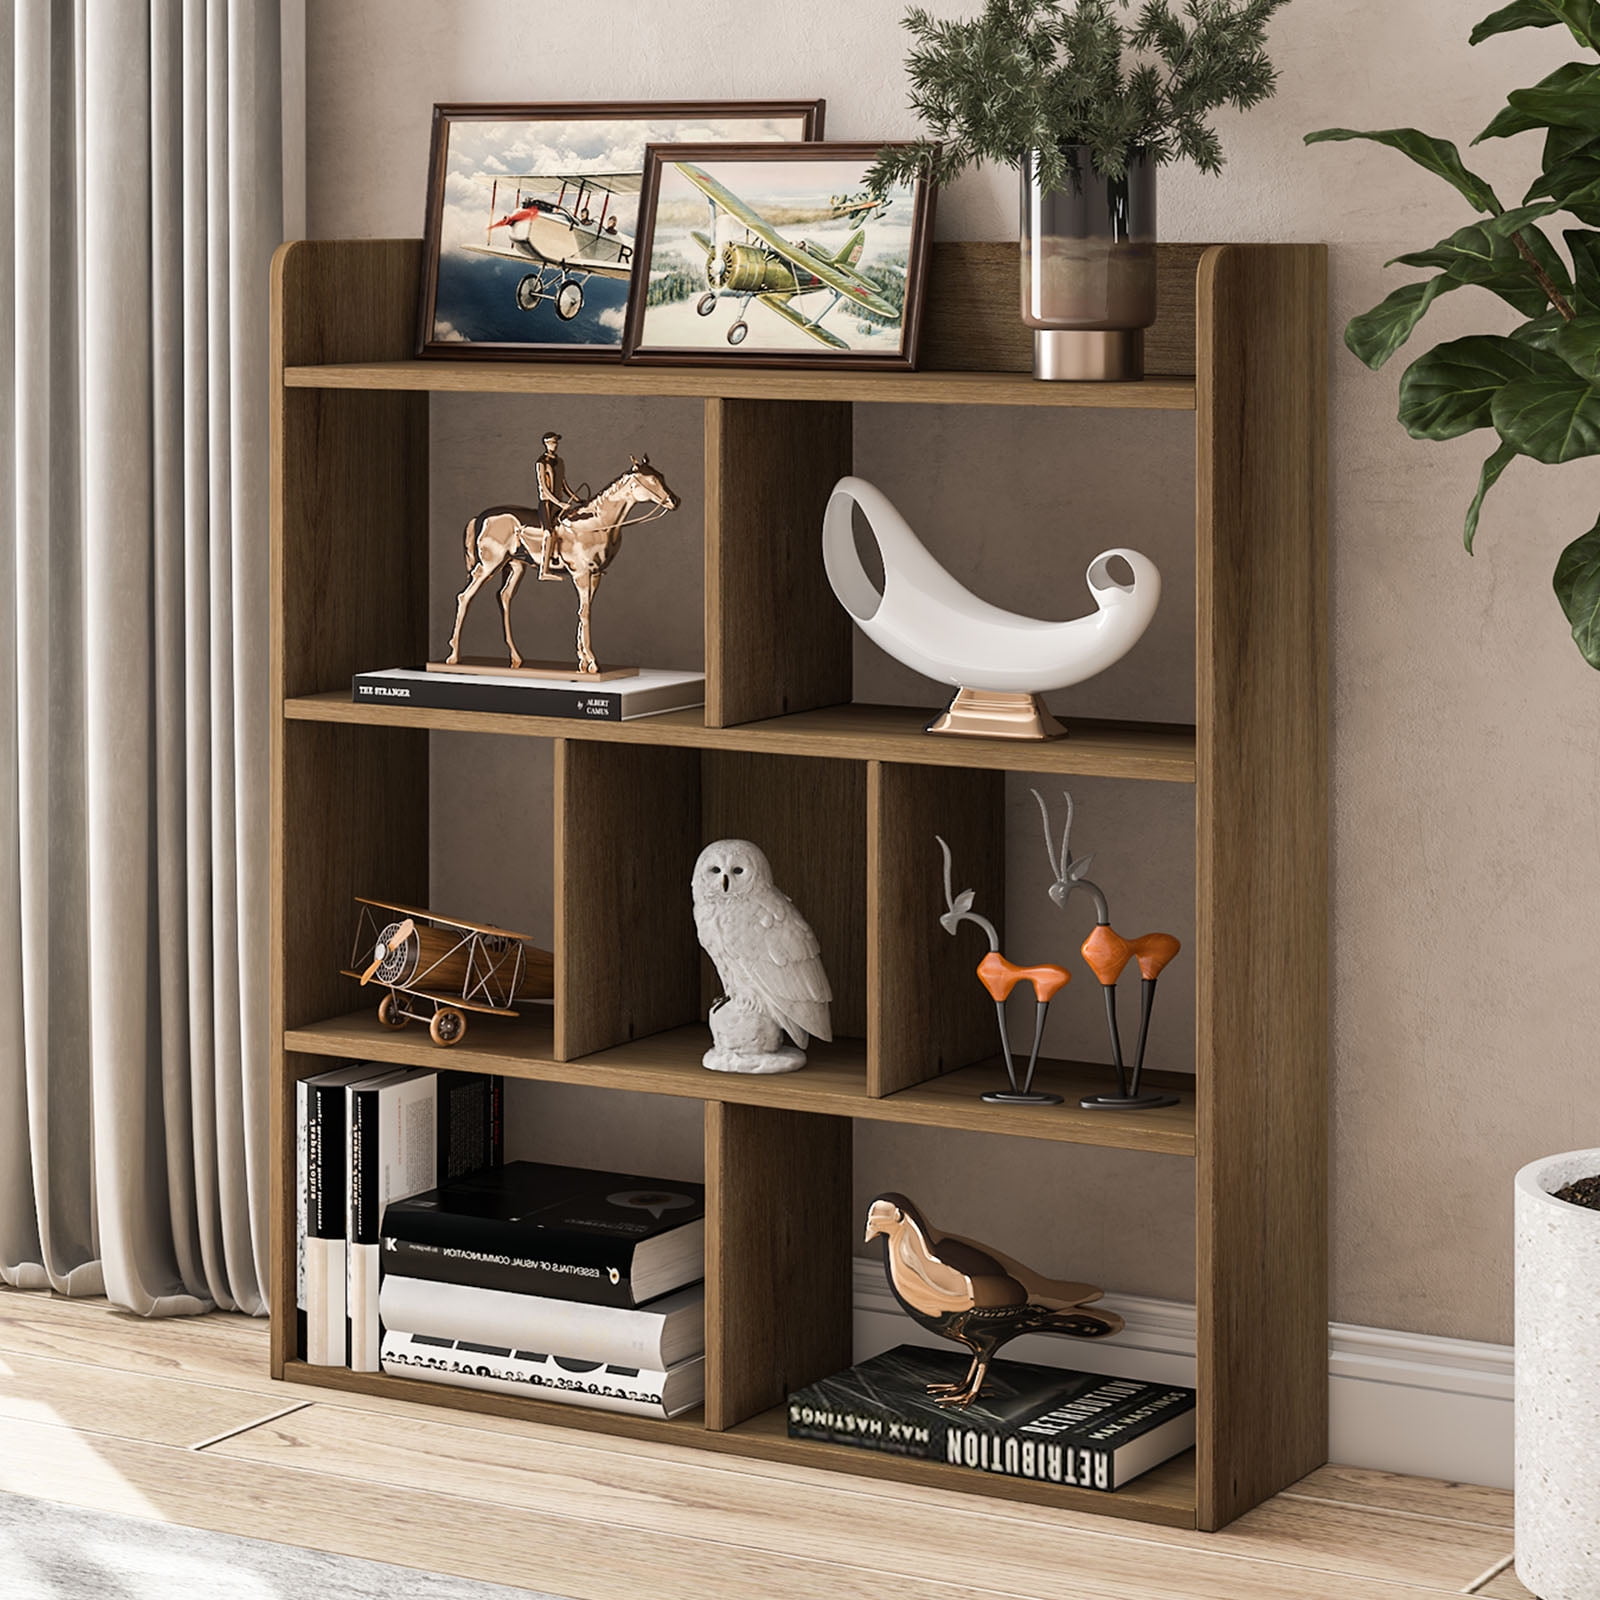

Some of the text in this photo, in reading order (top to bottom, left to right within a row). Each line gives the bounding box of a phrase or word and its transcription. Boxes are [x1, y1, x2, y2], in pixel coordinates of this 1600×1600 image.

[617, 245, 633, 264] R
[359, 686, 410, 698] THE STRANGER
[577, 701, 583, 710] by
[587, 699, 609, 708] ALBERT
[587, 707, 609, 716] CAMUS
[1018, 1380, 1149, 1436] RETRIBUTION
[1088, 1422, 1127, 1441] MAX
[1118, 1391, 1188, 1425] HASTINGS
[789, 1405, 883, 1435] HASTINGS
[889, 1422, 930, 1443] MAX
[946, 1427, 1109, 1490] RETRIBUTION
